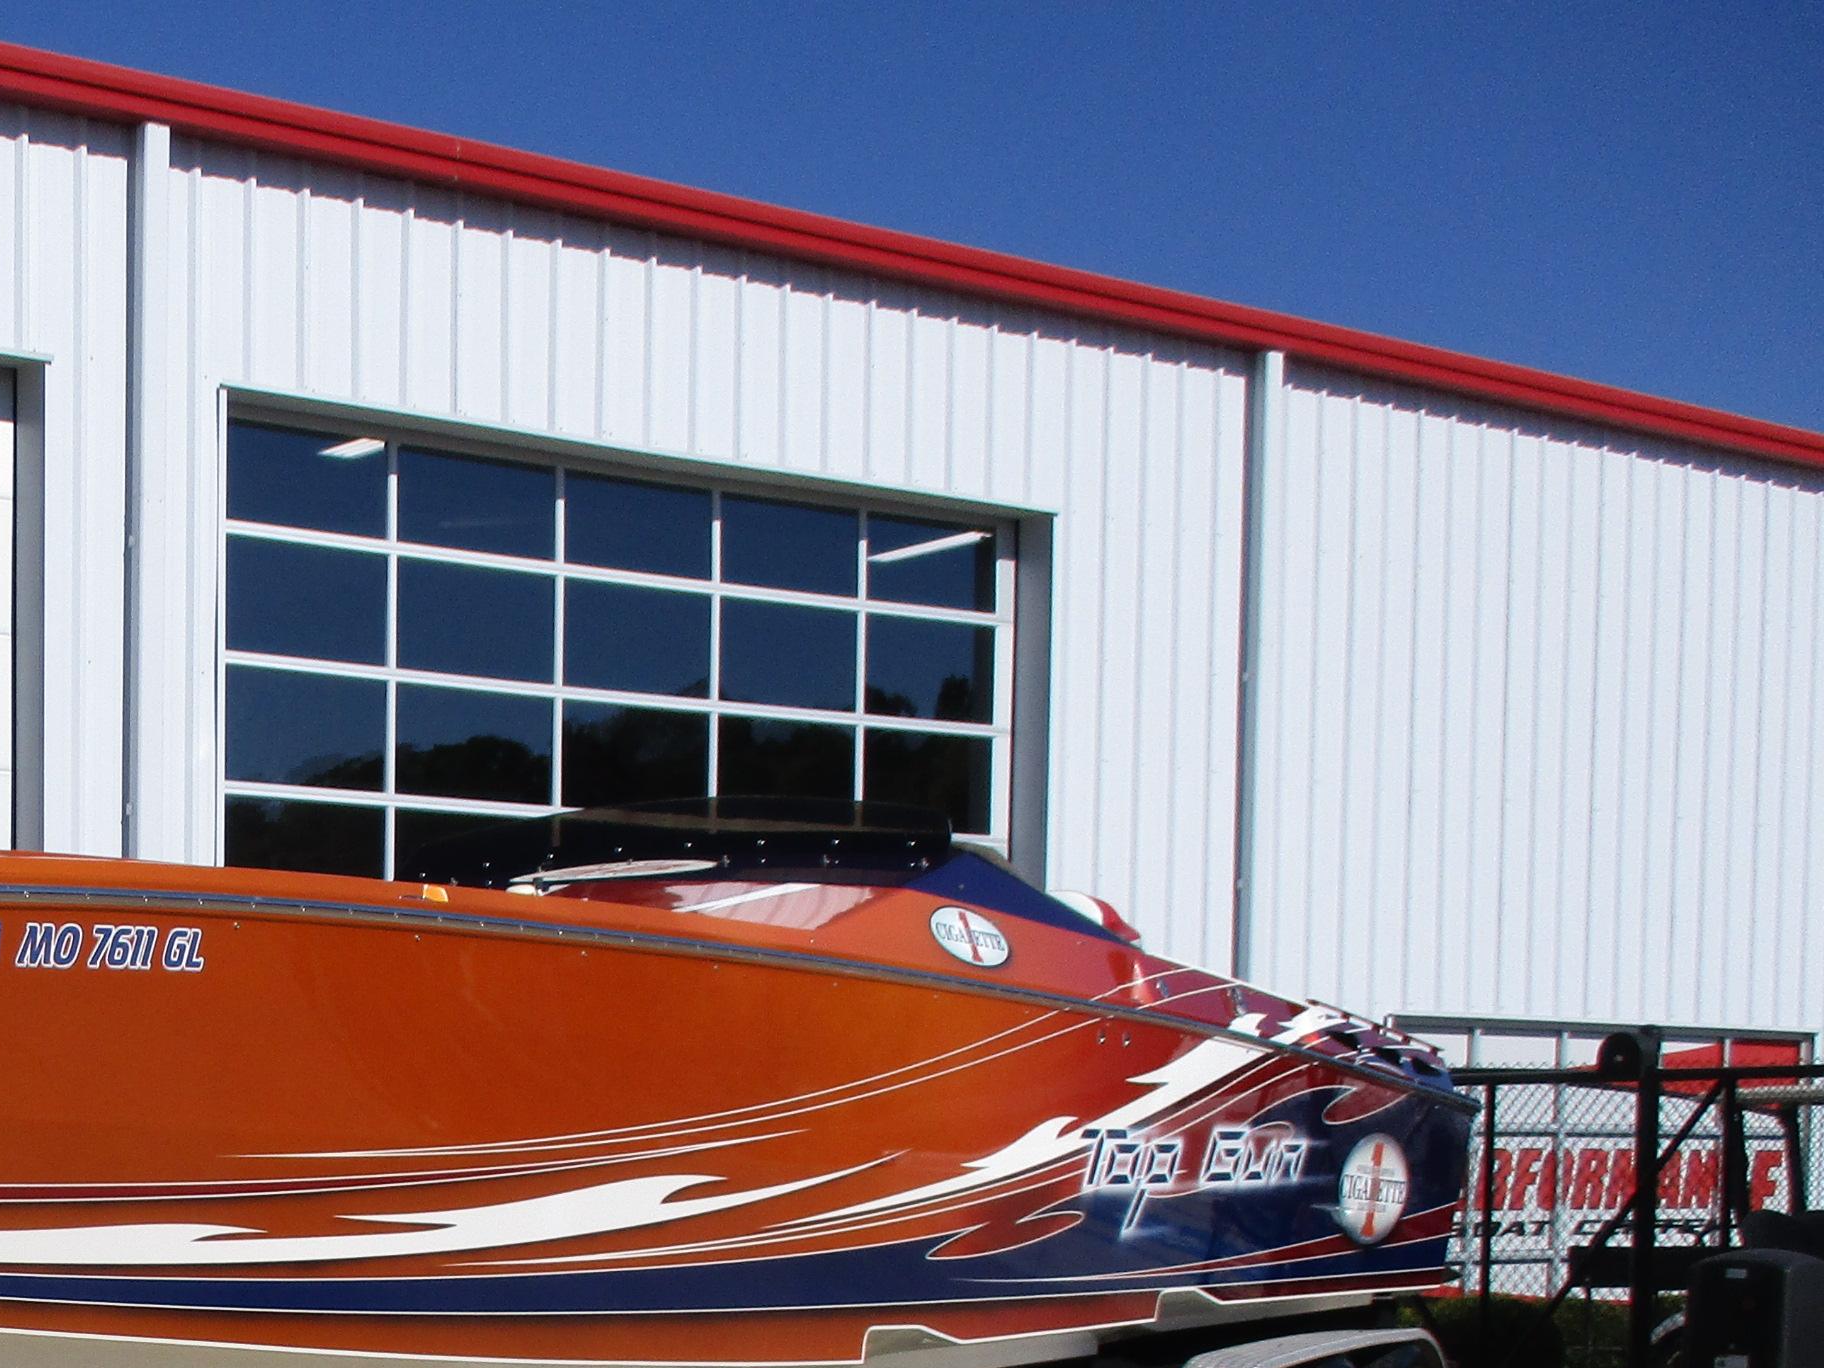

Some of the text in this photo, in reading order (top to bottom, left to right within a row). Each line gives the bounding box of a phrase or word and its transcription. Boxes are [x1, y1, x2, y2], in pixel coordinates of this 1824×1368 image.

[16, 923, 204, 972] MO 7611 GL
[1080, 1127, 1308, 1238] Top Gun
